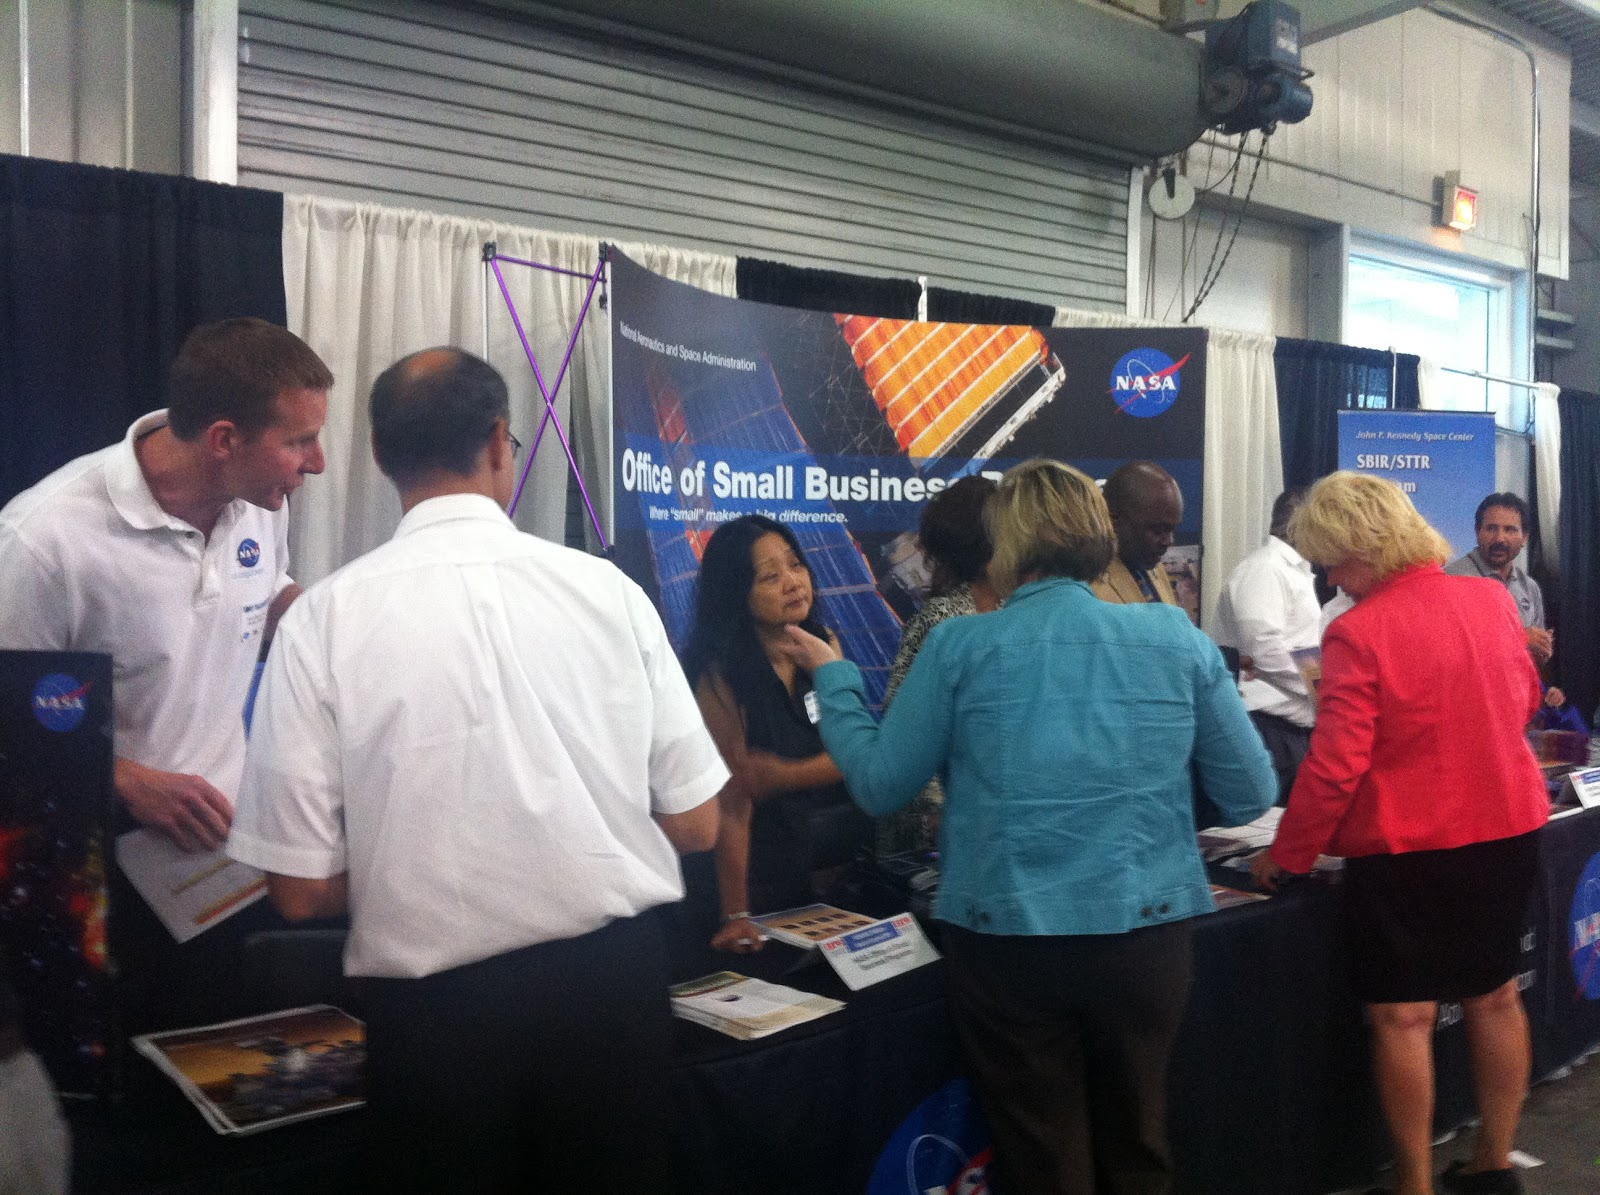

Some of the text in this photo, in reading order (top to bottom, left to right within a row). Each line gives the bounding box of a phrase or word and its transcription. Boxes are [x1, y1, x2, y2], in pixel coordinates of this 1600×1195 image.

[666, 343, 679, 357] and
[679, 344, 701, 362] Space
[702, 350, 757, 372] Administration
[1116, 375, 1176, 391] NASA
[1356, 431, 1376, 439] John
[1387, 432, 1421, 442] Kennedy
[1423, 432, 1448, 442] Space
[1448, 433, 1474, 442] Center
[1357, 454, 1430, 470] SBIR/STTR
[622, 447, 672, 495] Office
[680, 460, 706, 498] of
[713, 460, 794, 500] Small
[805, 465, 960, 503] Busines
[778, 508, 848, 524] difference.
[36, 695, 84, 711] NASA
